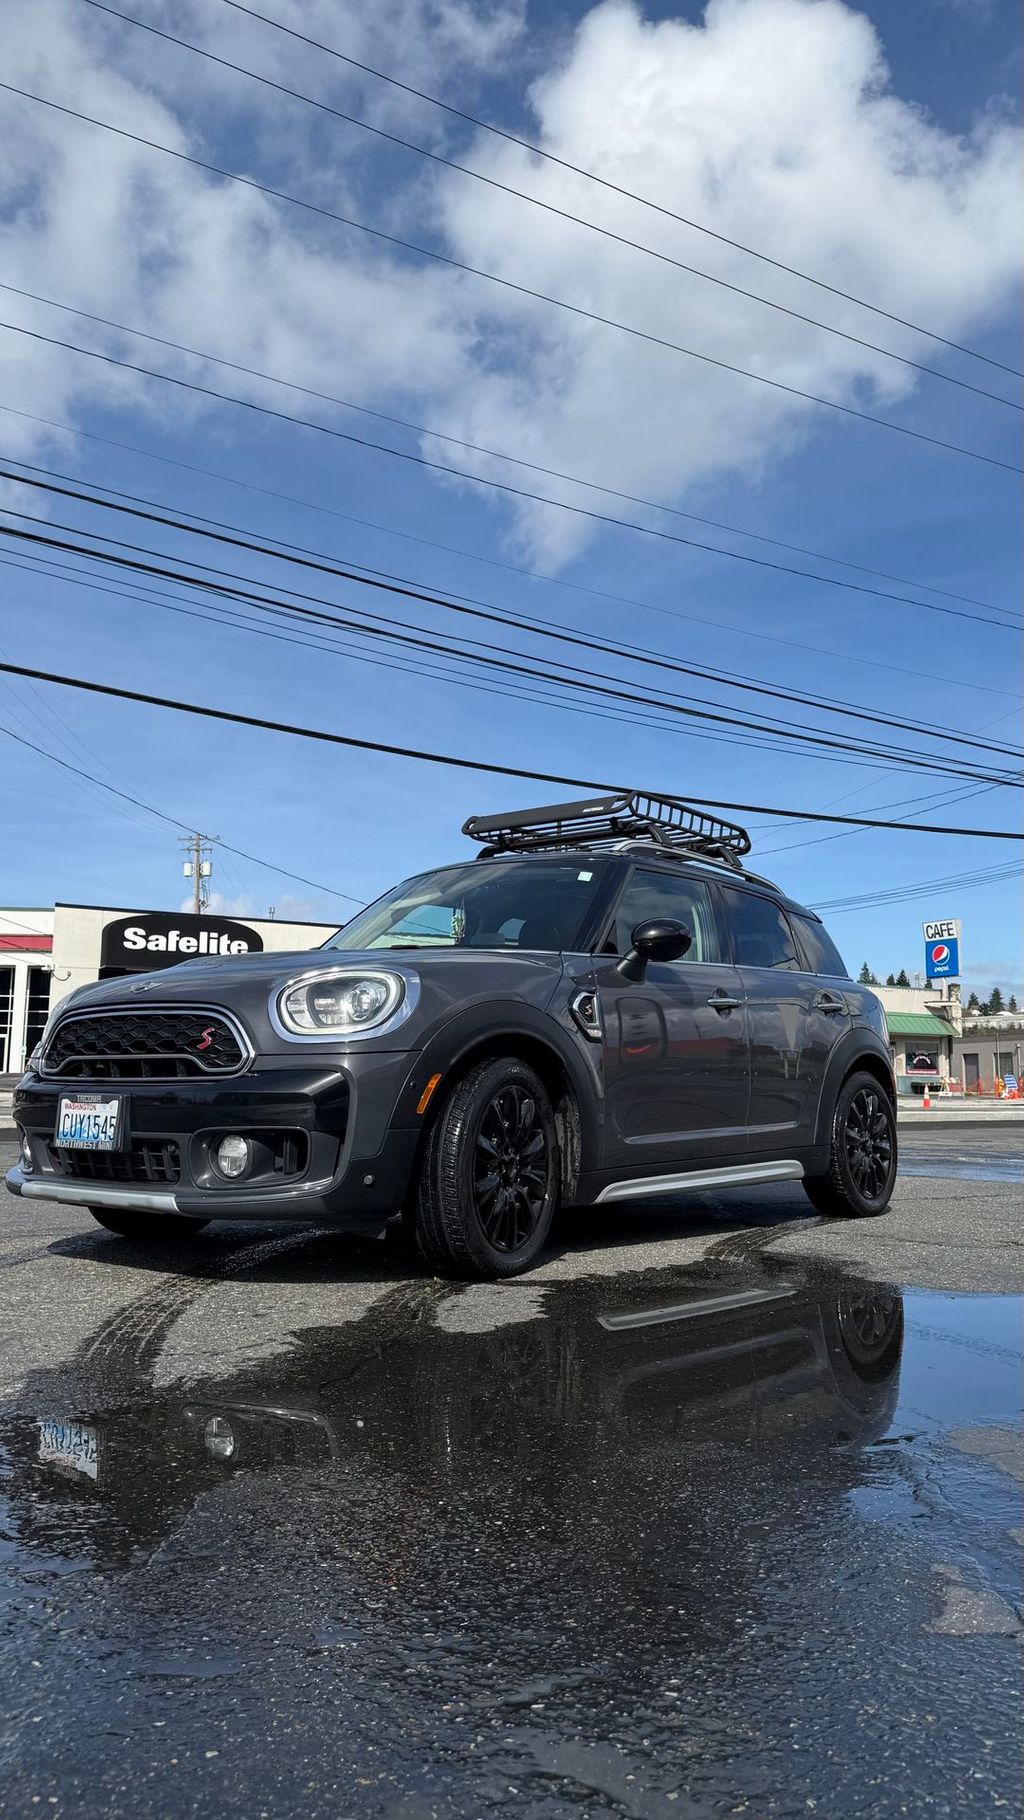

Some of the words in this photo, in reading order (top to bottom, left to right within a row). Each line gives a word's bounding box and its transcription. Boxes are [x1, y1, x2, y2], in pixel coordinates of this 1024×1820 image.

[926, 922, 954, 939] CAFE
[123, 927, 249, 955] Safelite
[77, 1095, 102, 1103] TACOMA
[65, 1103, 97, 1111] WASHINGTON
[62, 1113, 116, 1141] CUY1545
[55, 1138, 98, 1150] NORTHWEST
